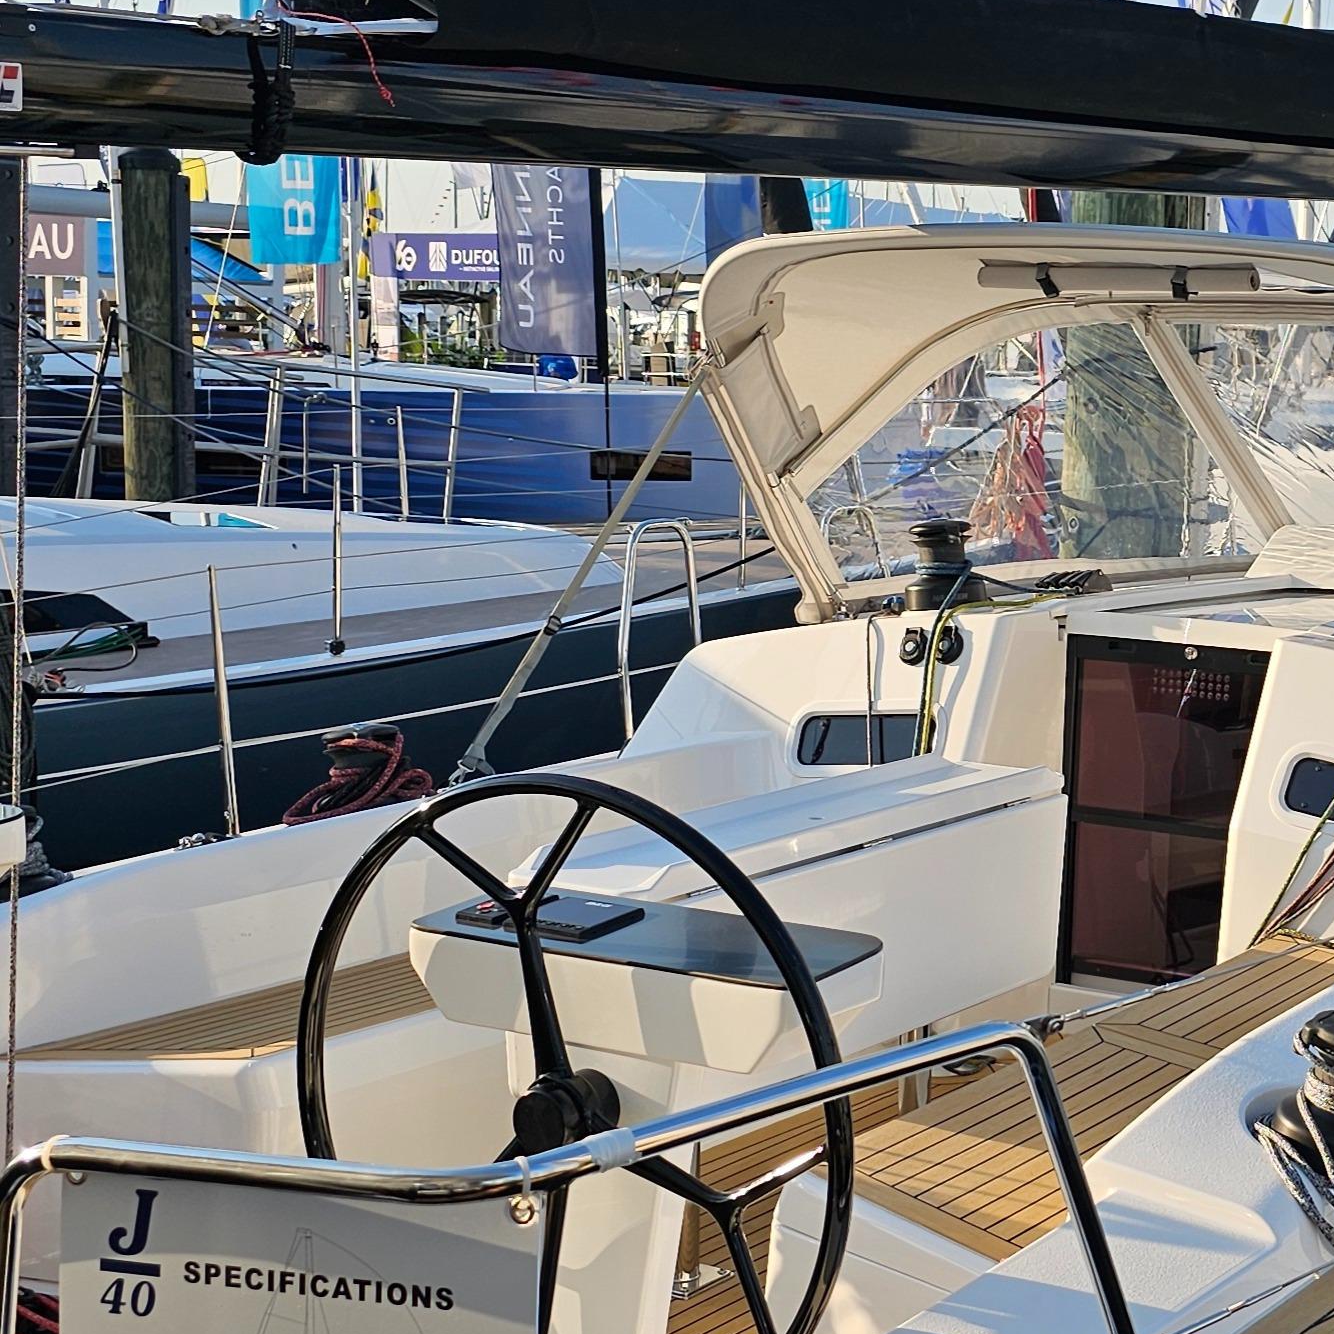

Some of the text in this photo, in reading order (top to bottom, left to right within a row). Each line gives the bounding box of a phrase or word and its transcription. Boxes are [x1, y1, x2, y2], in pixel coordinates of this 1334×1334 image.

[451, 249, 500, 266] DUFOU
[109, 1189, 158, 1255] J
[100, 1278, 157, 1317] 40
[184, 1260, 455, 1311] SPECIFICATIONS
